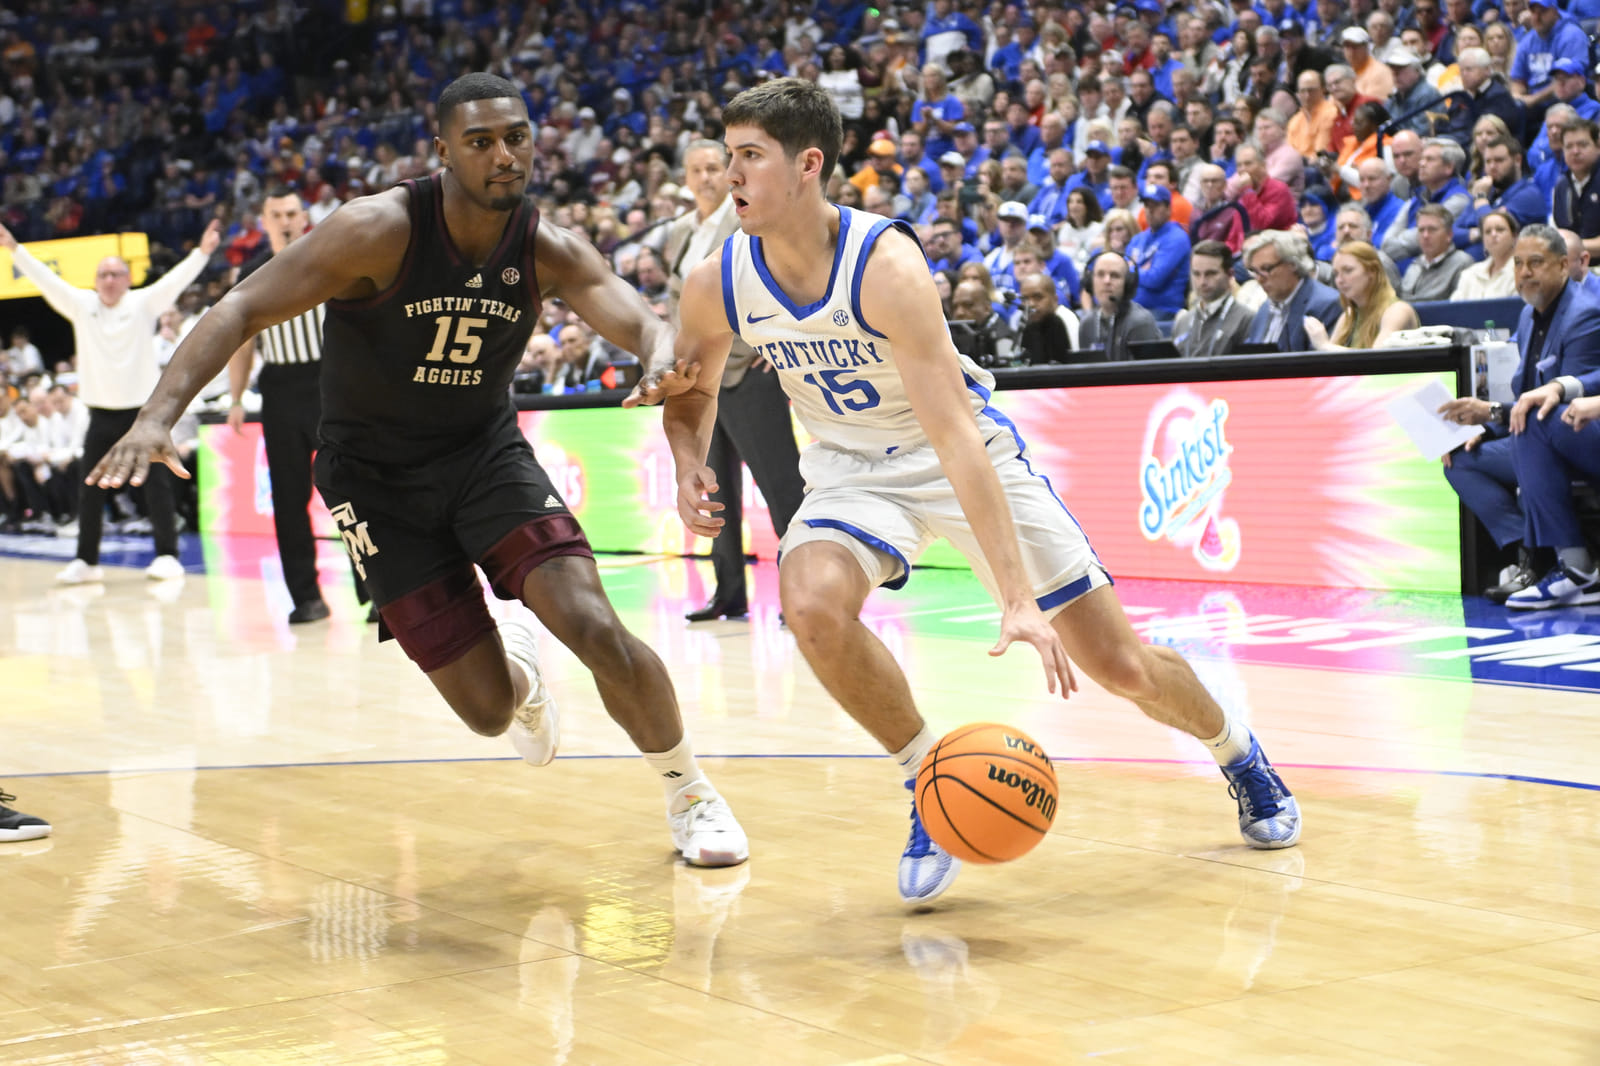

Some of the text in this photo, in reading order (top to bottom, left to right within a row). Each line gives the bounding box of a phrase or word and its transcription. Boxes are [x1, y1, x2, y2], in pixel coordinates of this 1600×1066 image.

[503, 268, 519, 284] SEC
[404, 297, 522, 323] FIGHTIN' TEXAS
[834, 310, 848, 325] SEC
[425, 316, 488, 364] 15
[413, 366, 483, 386] AGGIES
[803, 369, 881, 415] 15
[1143, 404, 1225, 534] Sunkist
[988, 764, 1057, 822] Wilson
